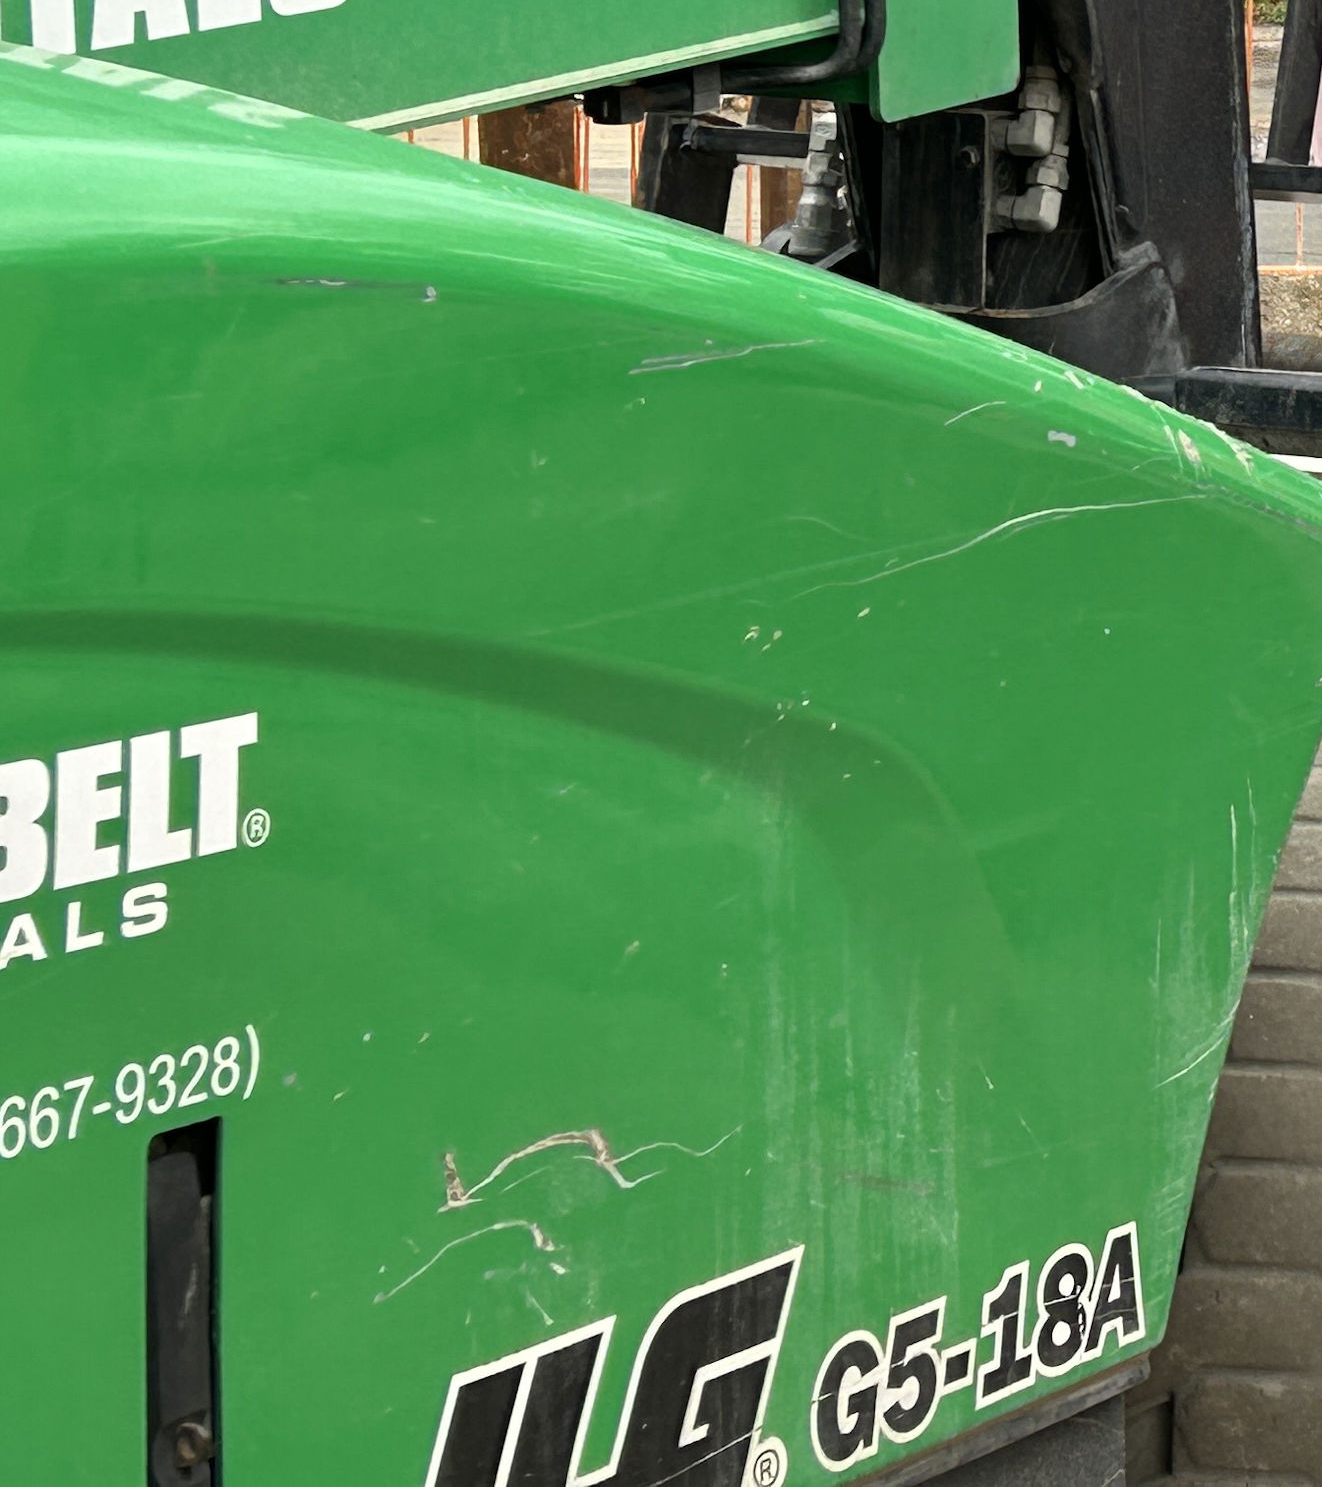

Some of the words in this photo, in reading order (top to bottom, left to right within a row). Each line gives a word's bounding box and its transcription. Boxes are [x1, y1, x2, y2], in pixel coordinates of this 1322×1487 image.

[0, 881, 169, 971] ALS
[0, 1024, 261, 1159] 667-9328)
[811, 1220, 1146, 1472] G5-18A
